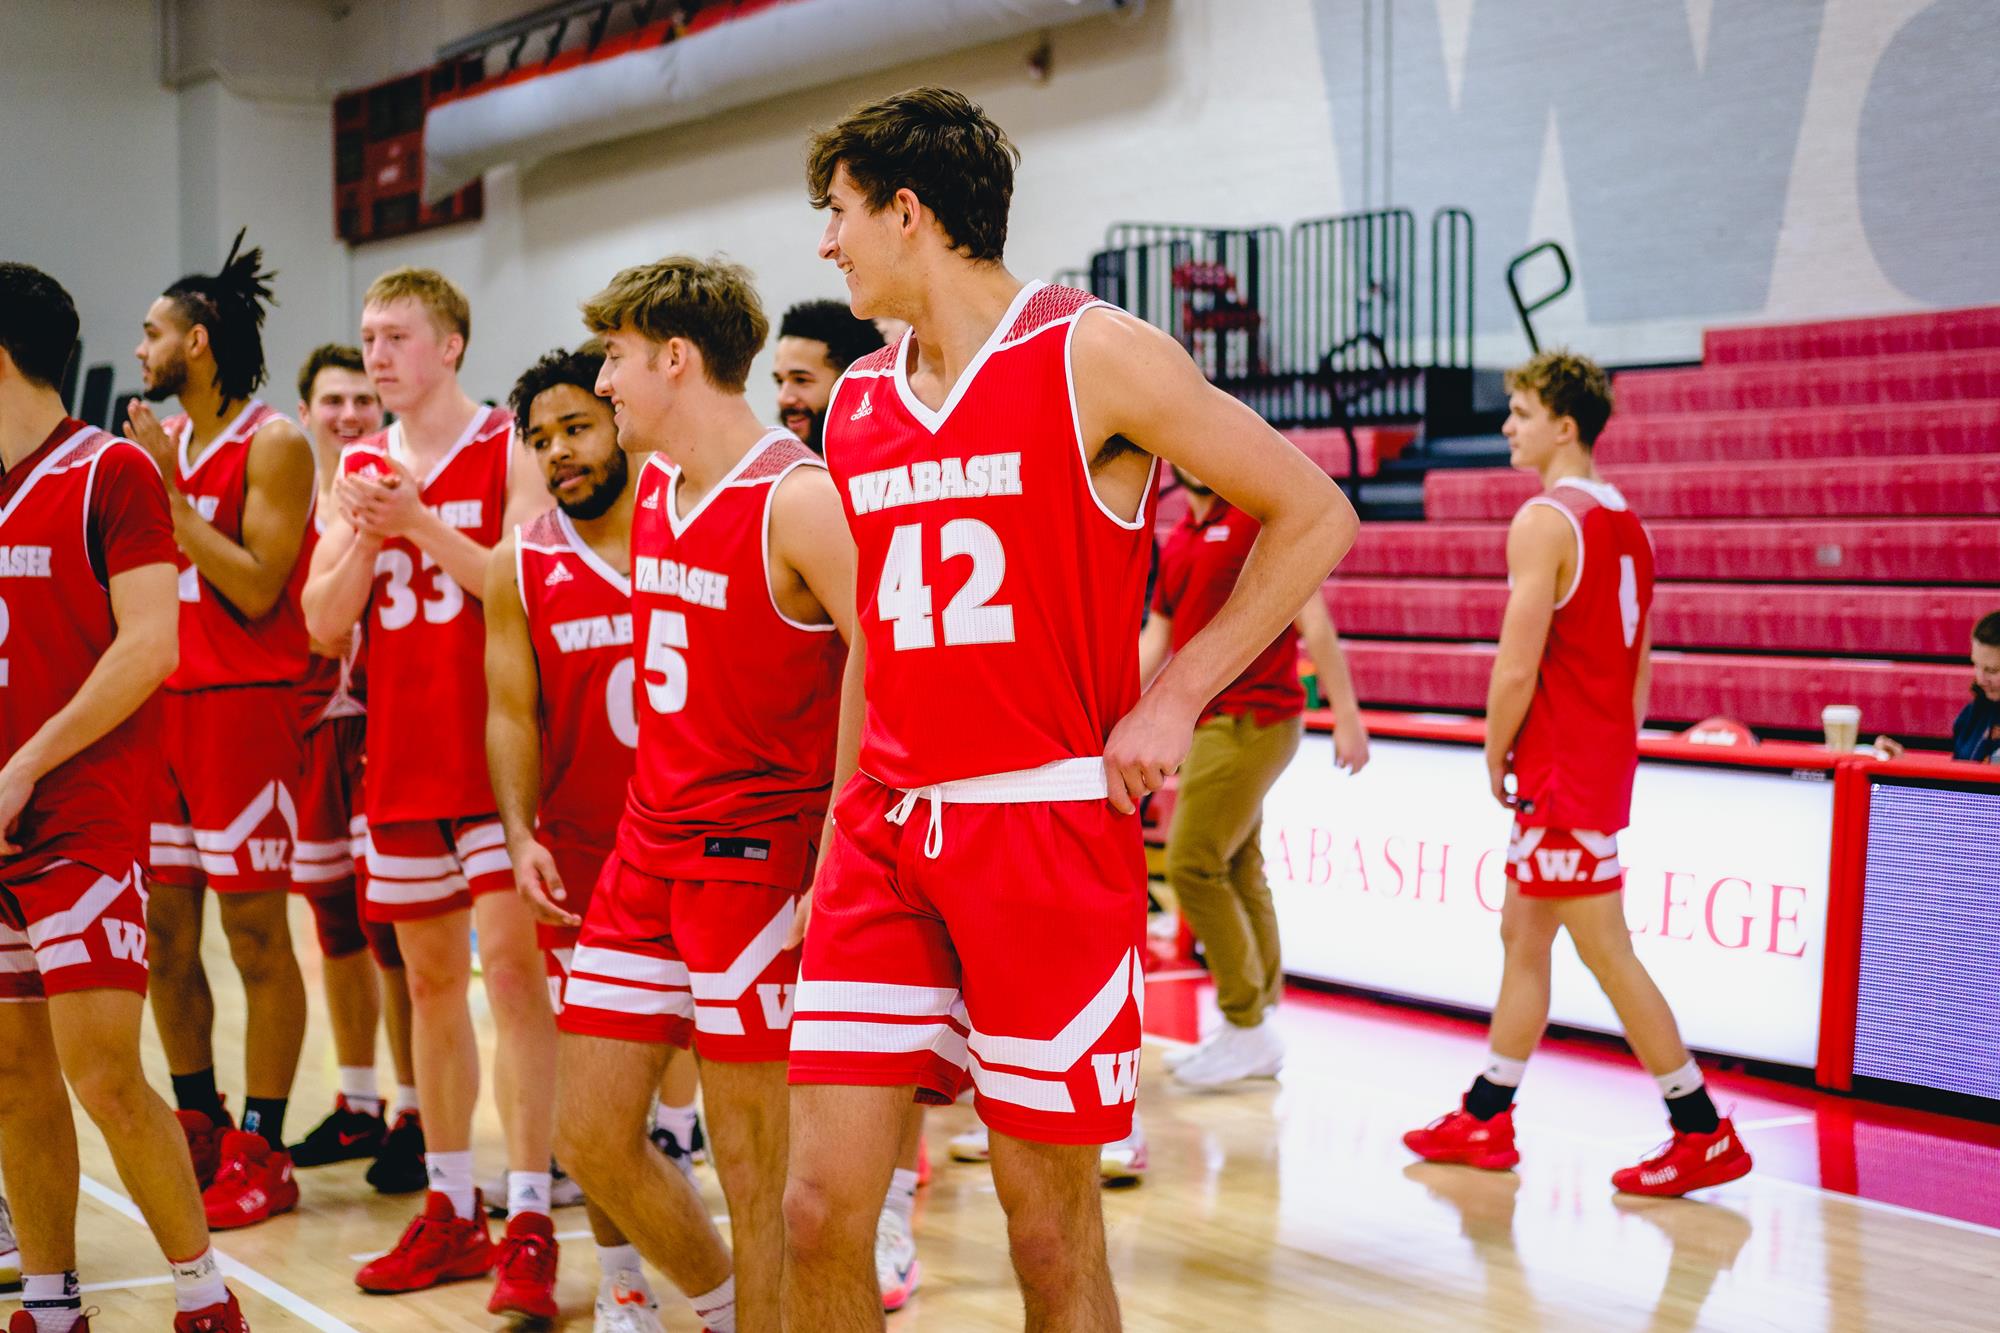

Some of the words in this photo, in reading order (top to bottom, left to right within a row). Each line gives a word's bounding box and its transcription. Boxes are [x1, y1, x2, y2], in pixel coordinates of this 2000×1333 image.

[848, 451, 1023, 516] WABASH
[374, 548, 464, 631] 33
[635, 555, 729, 611] ABASH
[877, 517, 1016, 652] 42
[550, 612, 634, 654] WAB
[644, 608, 689, 714] 5
[1262, 826, 1451, 903] ABASH
